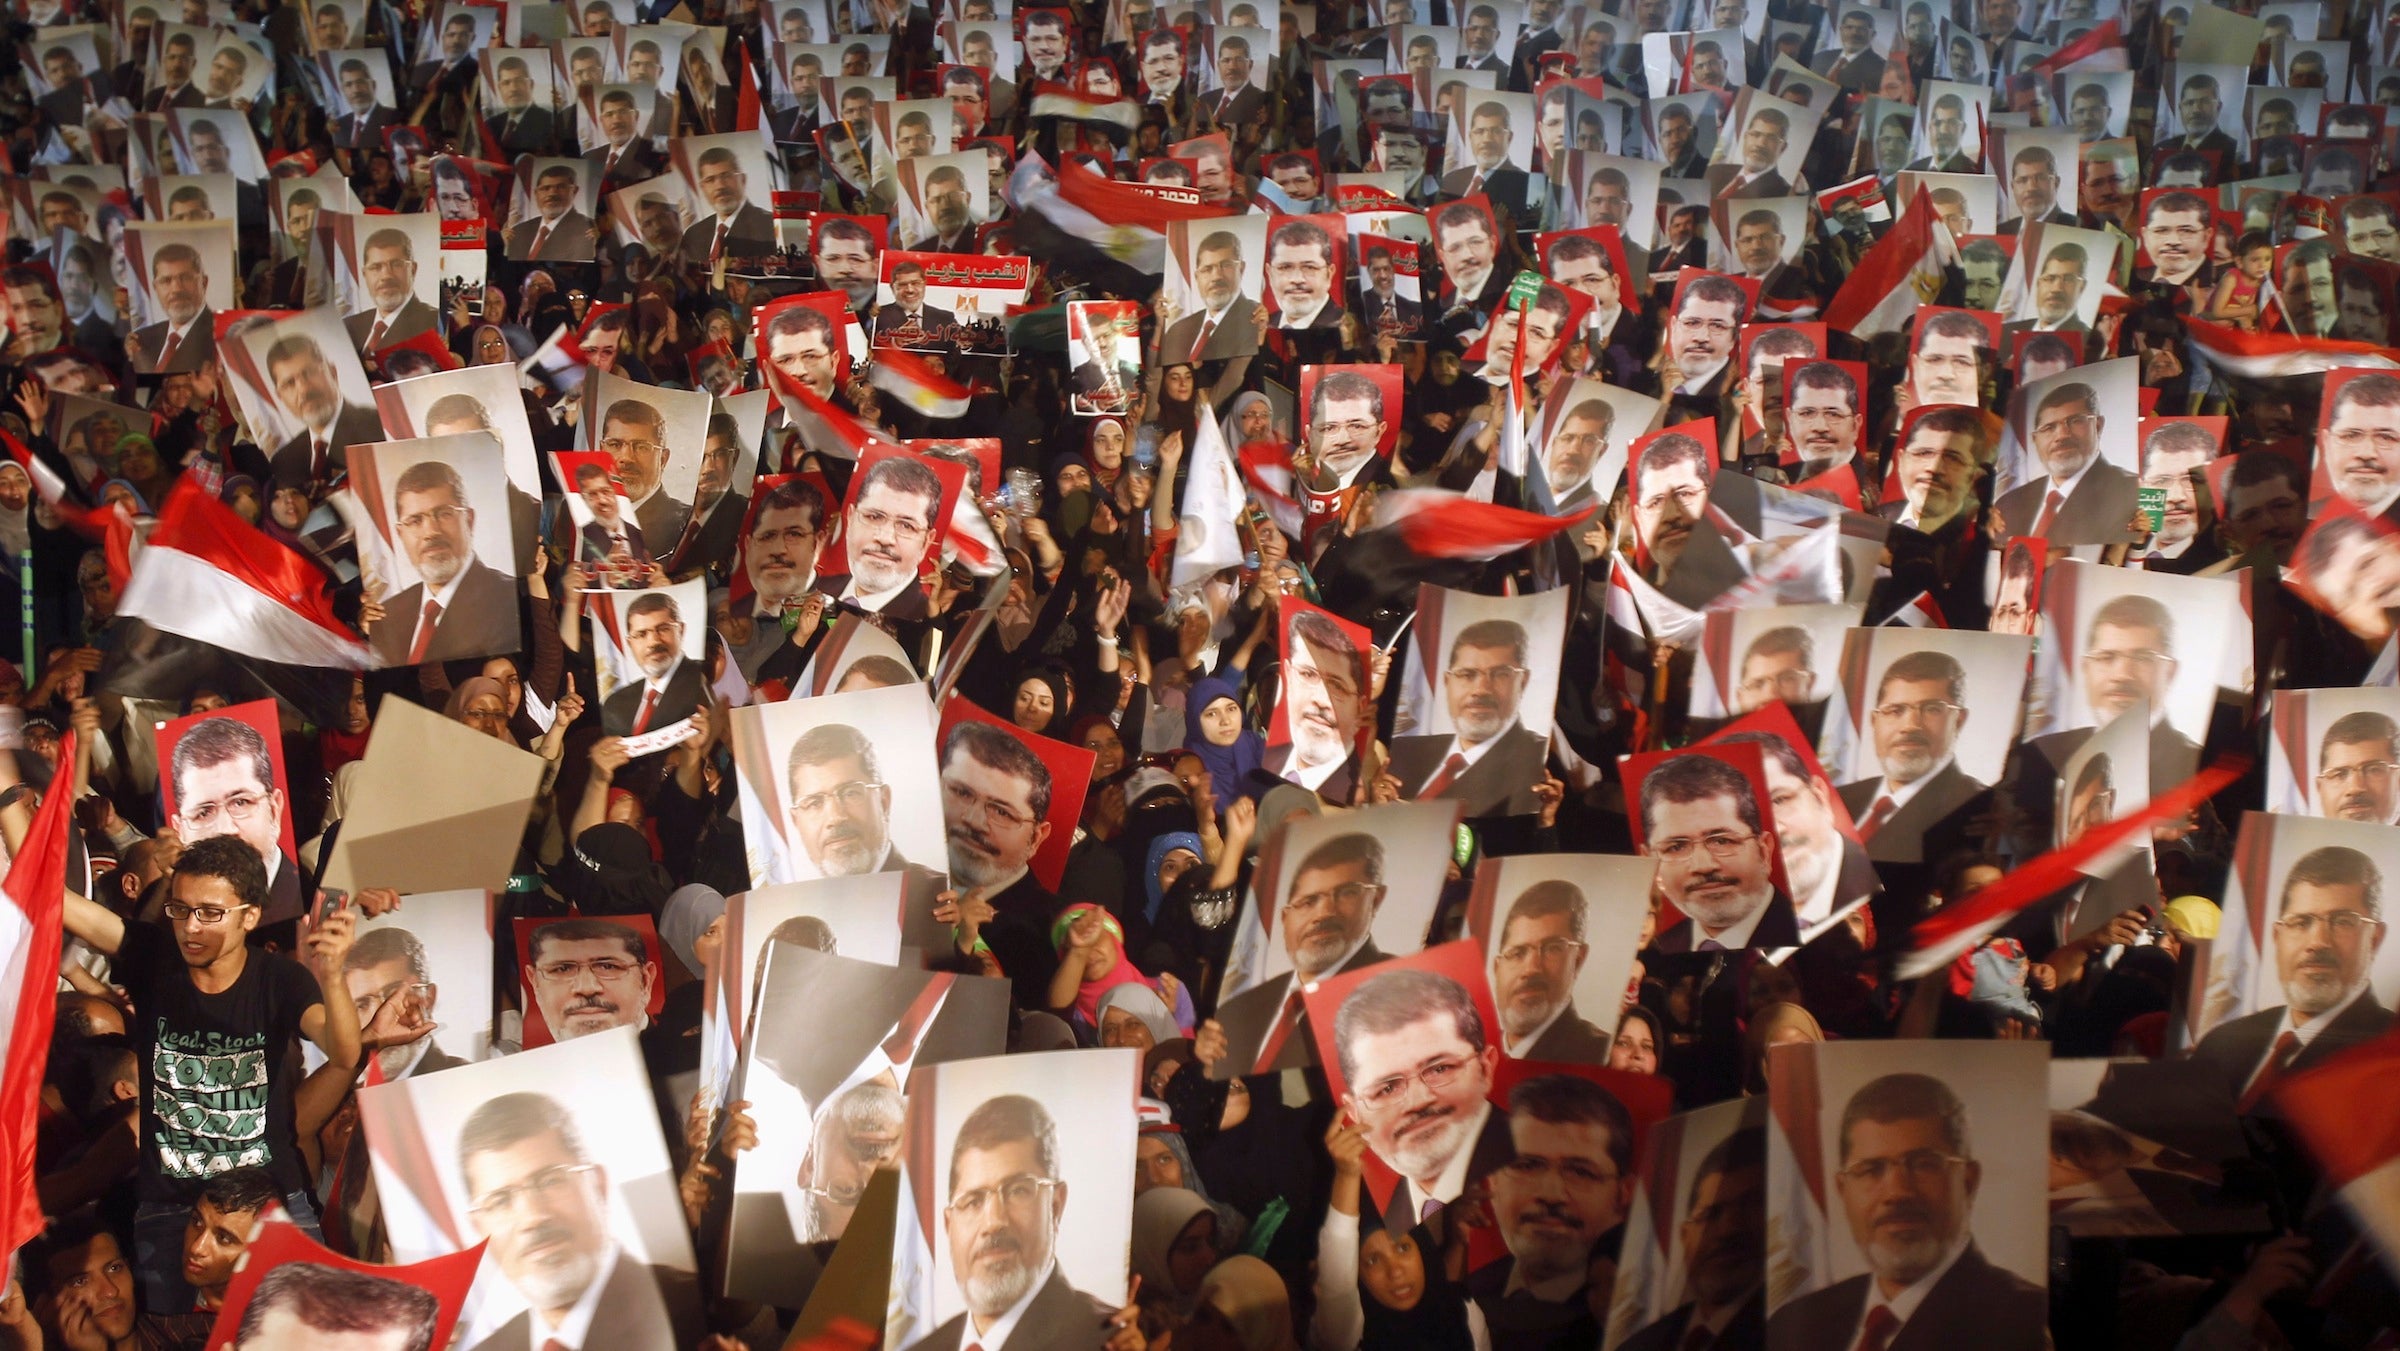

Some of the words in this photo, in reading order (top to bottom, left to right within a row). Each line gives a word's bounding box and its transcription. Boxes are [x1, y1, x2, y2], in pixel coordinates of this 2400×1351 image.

[1158, 189, 1199, 205] محمد
[924, 261, 971, 284] يؤيد
[971, 262, 1026, 284] الشعب
[154, 1053, 262, 1088] CORE
[170, 1086, 269, 1111] ENIM
[155, 1091, 261, 1137] WORK
